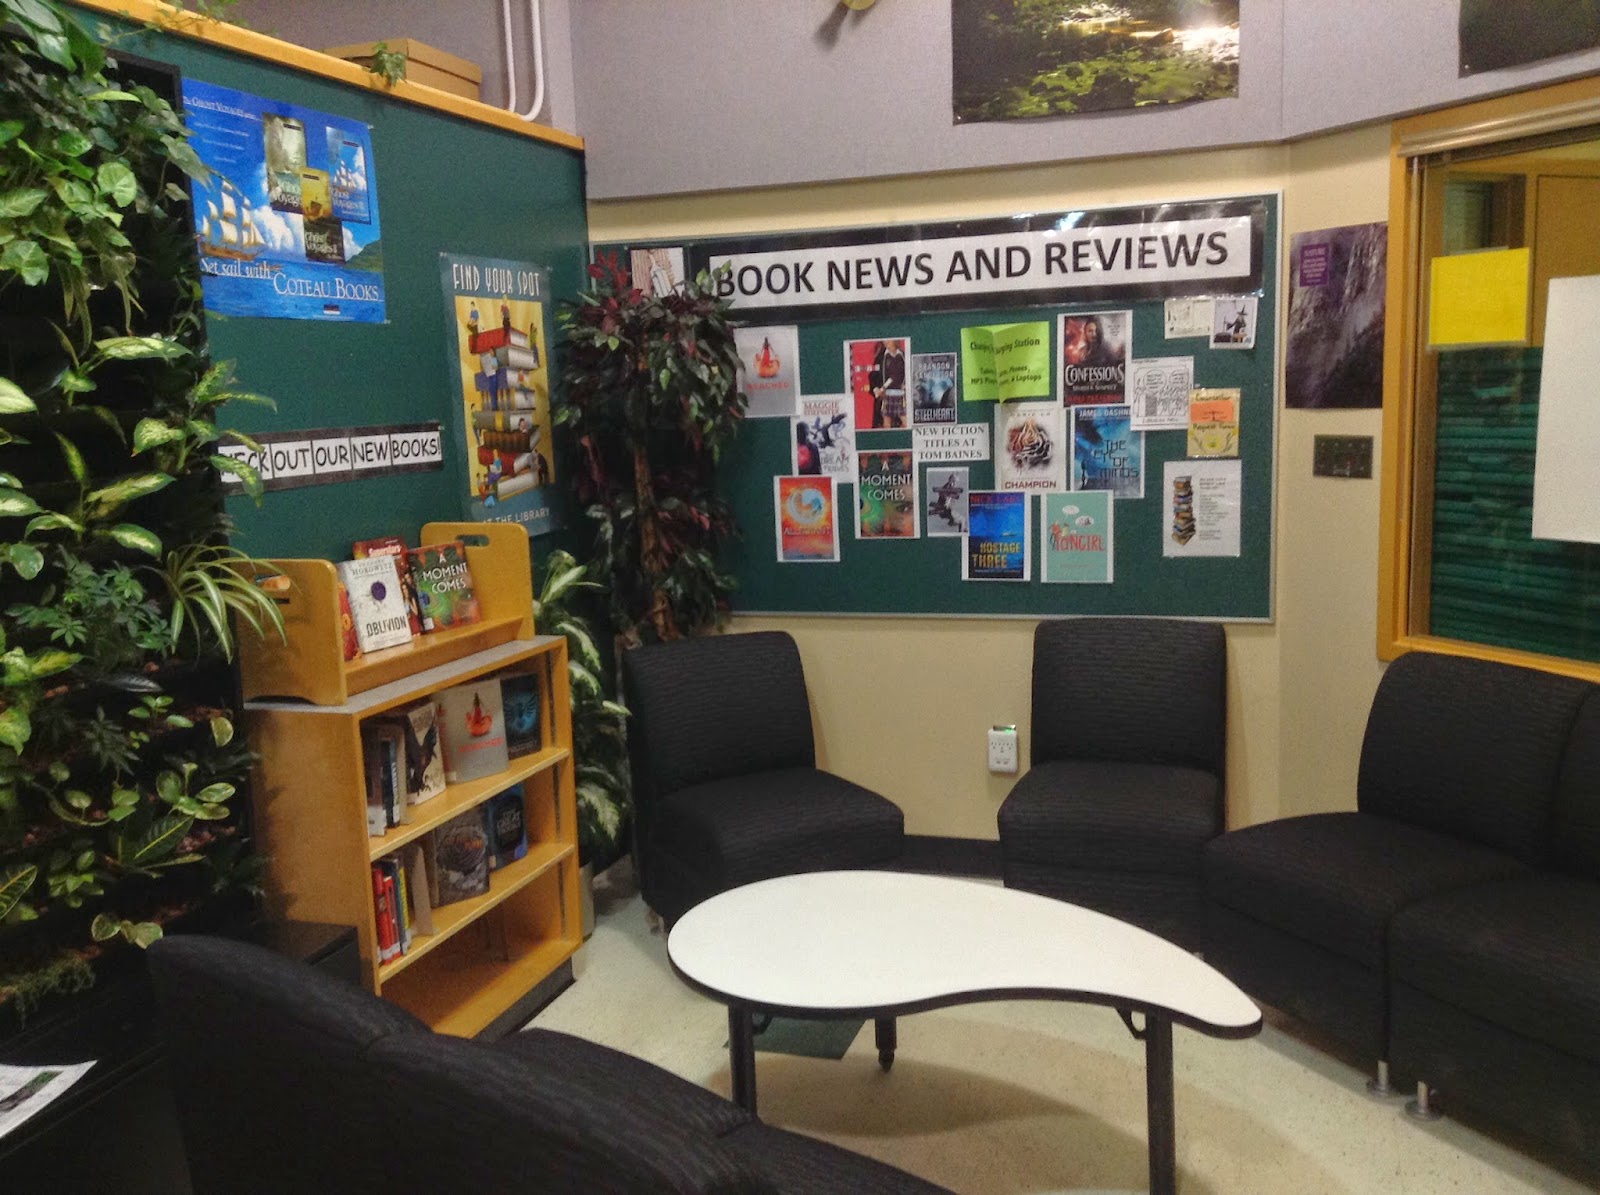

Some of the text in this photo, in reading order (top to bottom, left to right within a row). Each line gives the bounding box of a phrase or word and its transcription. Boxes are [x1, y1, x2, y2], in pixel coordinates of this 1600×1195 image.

[221, 258, 241, 276] sail
[245, 261, 271, 279] with
[717, 231, 1229, 297] BOOK NEWS AND REVIEWS
[273, 272, 379, 300] COTEAU BOOKS
[452, 263, 539, 297] FIND YOUR SPOT
[1014, 337, 1040, 348] Station
[1065, 363, 1125, 386] CONFESSIONS
[804, 402, 839, 411] MAGGIE
[915, 407, 954, 420] STEELHEART
[915, 425, 985, 436] NEW FICTION
[924, 438, 977, 448] TITLES AT
[274, 448, 310, 471] OUT
[315, 446, 348, 466] OUR
[352, 441, 389, 464] NEW
[392, 437, 441, 459] BOOKS!
[919, 449, 982, 460] TOM BAINES
[881, 463, 890, 471] A
[861, 473, 911, 485] MOMENT
[1004, 480, 1057, 489] CHAMPION
[867, 489, 906, 501] COMES
[515, 507, 550, 523] LIBRARY
[980, 542, 1020, 554] HOSTAGE
[438, 553, 447, 563] A
[972, 553, 1007, 568] THREE
[352, 561, 393, 576] HOROWITZ
[422, 562, 468, 582] MOMENT
[431, 578, 466, 594] COMES
[366, 616, 406, 637] OBLIVION
